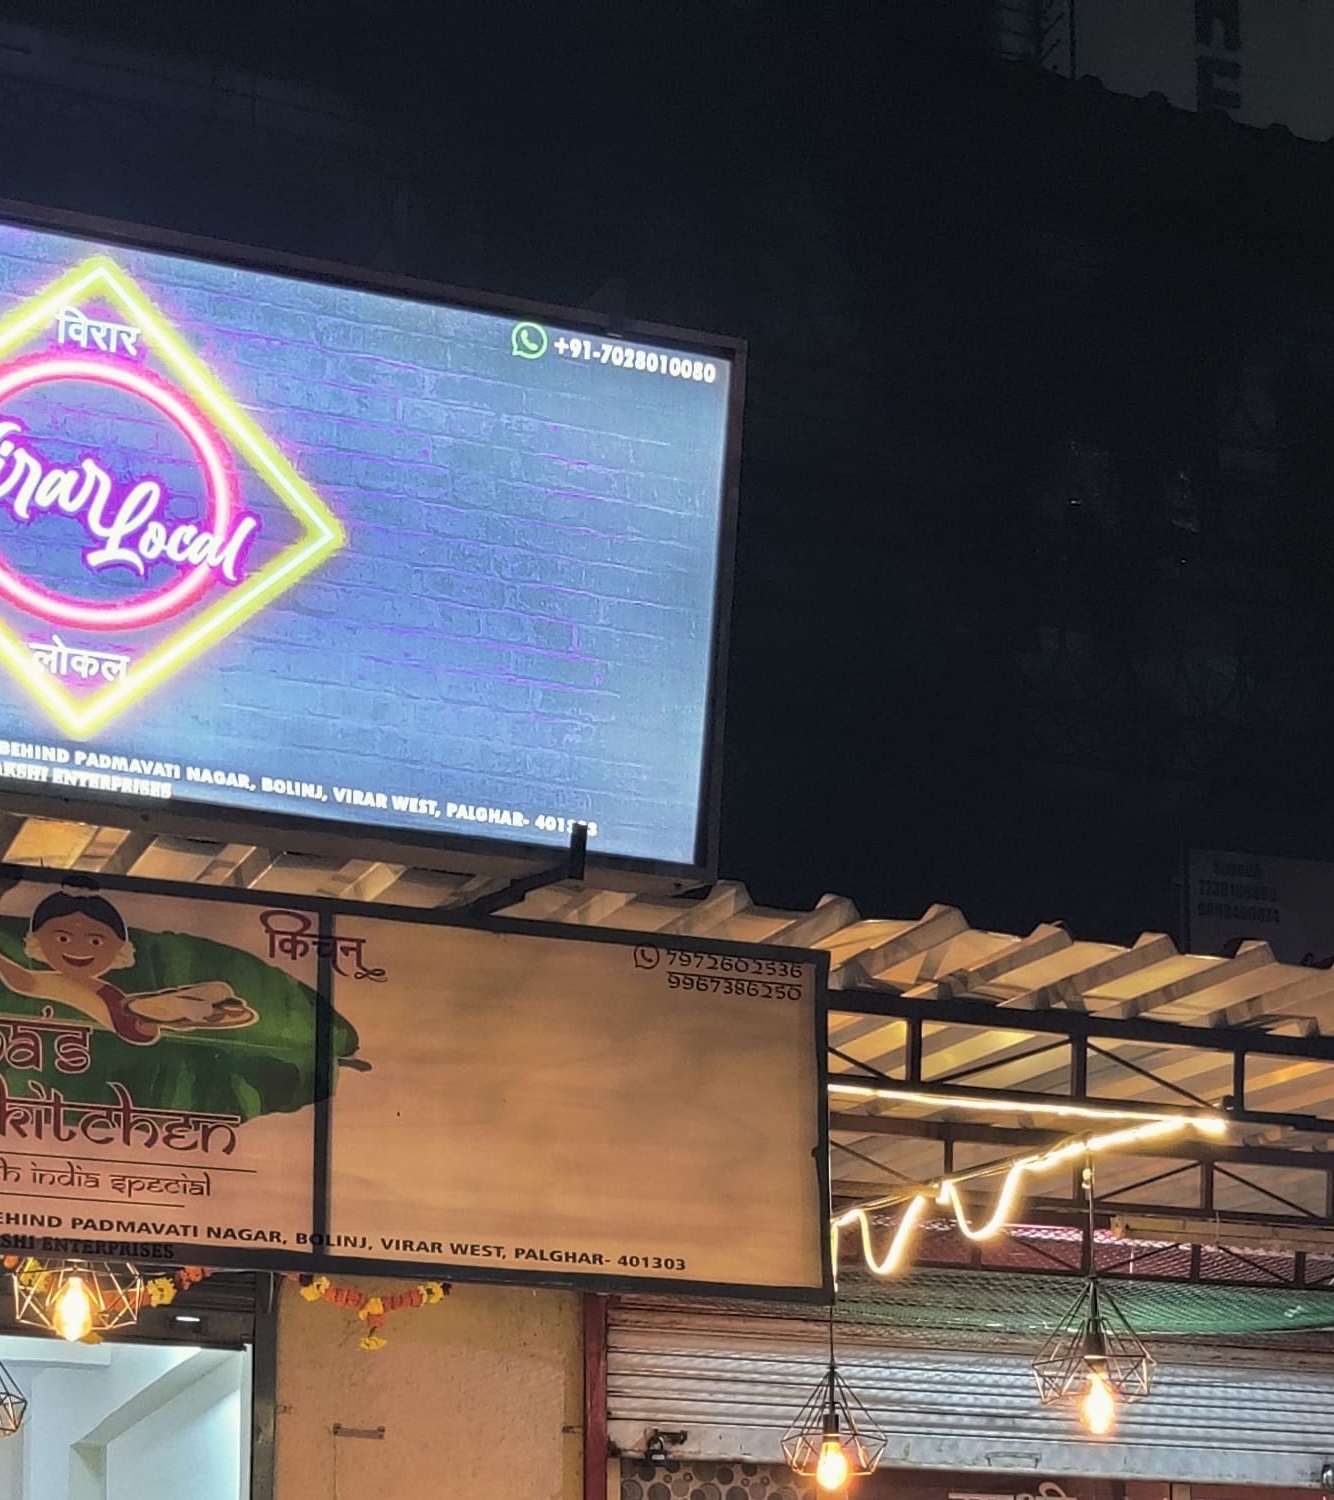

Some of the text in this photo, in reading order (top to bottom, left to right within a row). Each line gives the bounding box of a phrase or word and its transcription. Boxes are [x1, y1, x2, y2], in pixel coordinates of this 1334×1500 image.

[54, 305, 141, 357] विरार
[553, 336, 717, 384] +91-7028010080
[86, 486, 258, 582] Local
[28, 633, 131, 683] लोकल
[52, 765, 173, 800] ENTERPRISES
[74, 750, 182, 780] PADMAVATI
[185, 766, 257, 793] NAGAR,
[260, 776, 329, 803] BOLINJ,
[332, 786, 389, 810] VIRAR
[391, 795, 442, 818] WEST,
[445, 803, 530, 828] PALGHAR-
[666, 948, 803, 979] 7972602536
[666, 971, 803, 1001] 9967386250
[30, 1160, 101, 1191] india
[110, 1170, 212, 1199] special
[41, 1237, 176, 1260] ENTERPRISES
[70, 1217, 200, 1239] PADMAVATI
[205, 1226, 289, 1248] NAGAR,
[294, 1231, 374, 1253] BOLINJ,
[379, 1237, 445, 1256] VIRAR
[448, 1242, 507, 1262] WEST,
[513, 1246, 612, 1268] PALGHAR-
[616, 1253, 687, 1272] 401303
